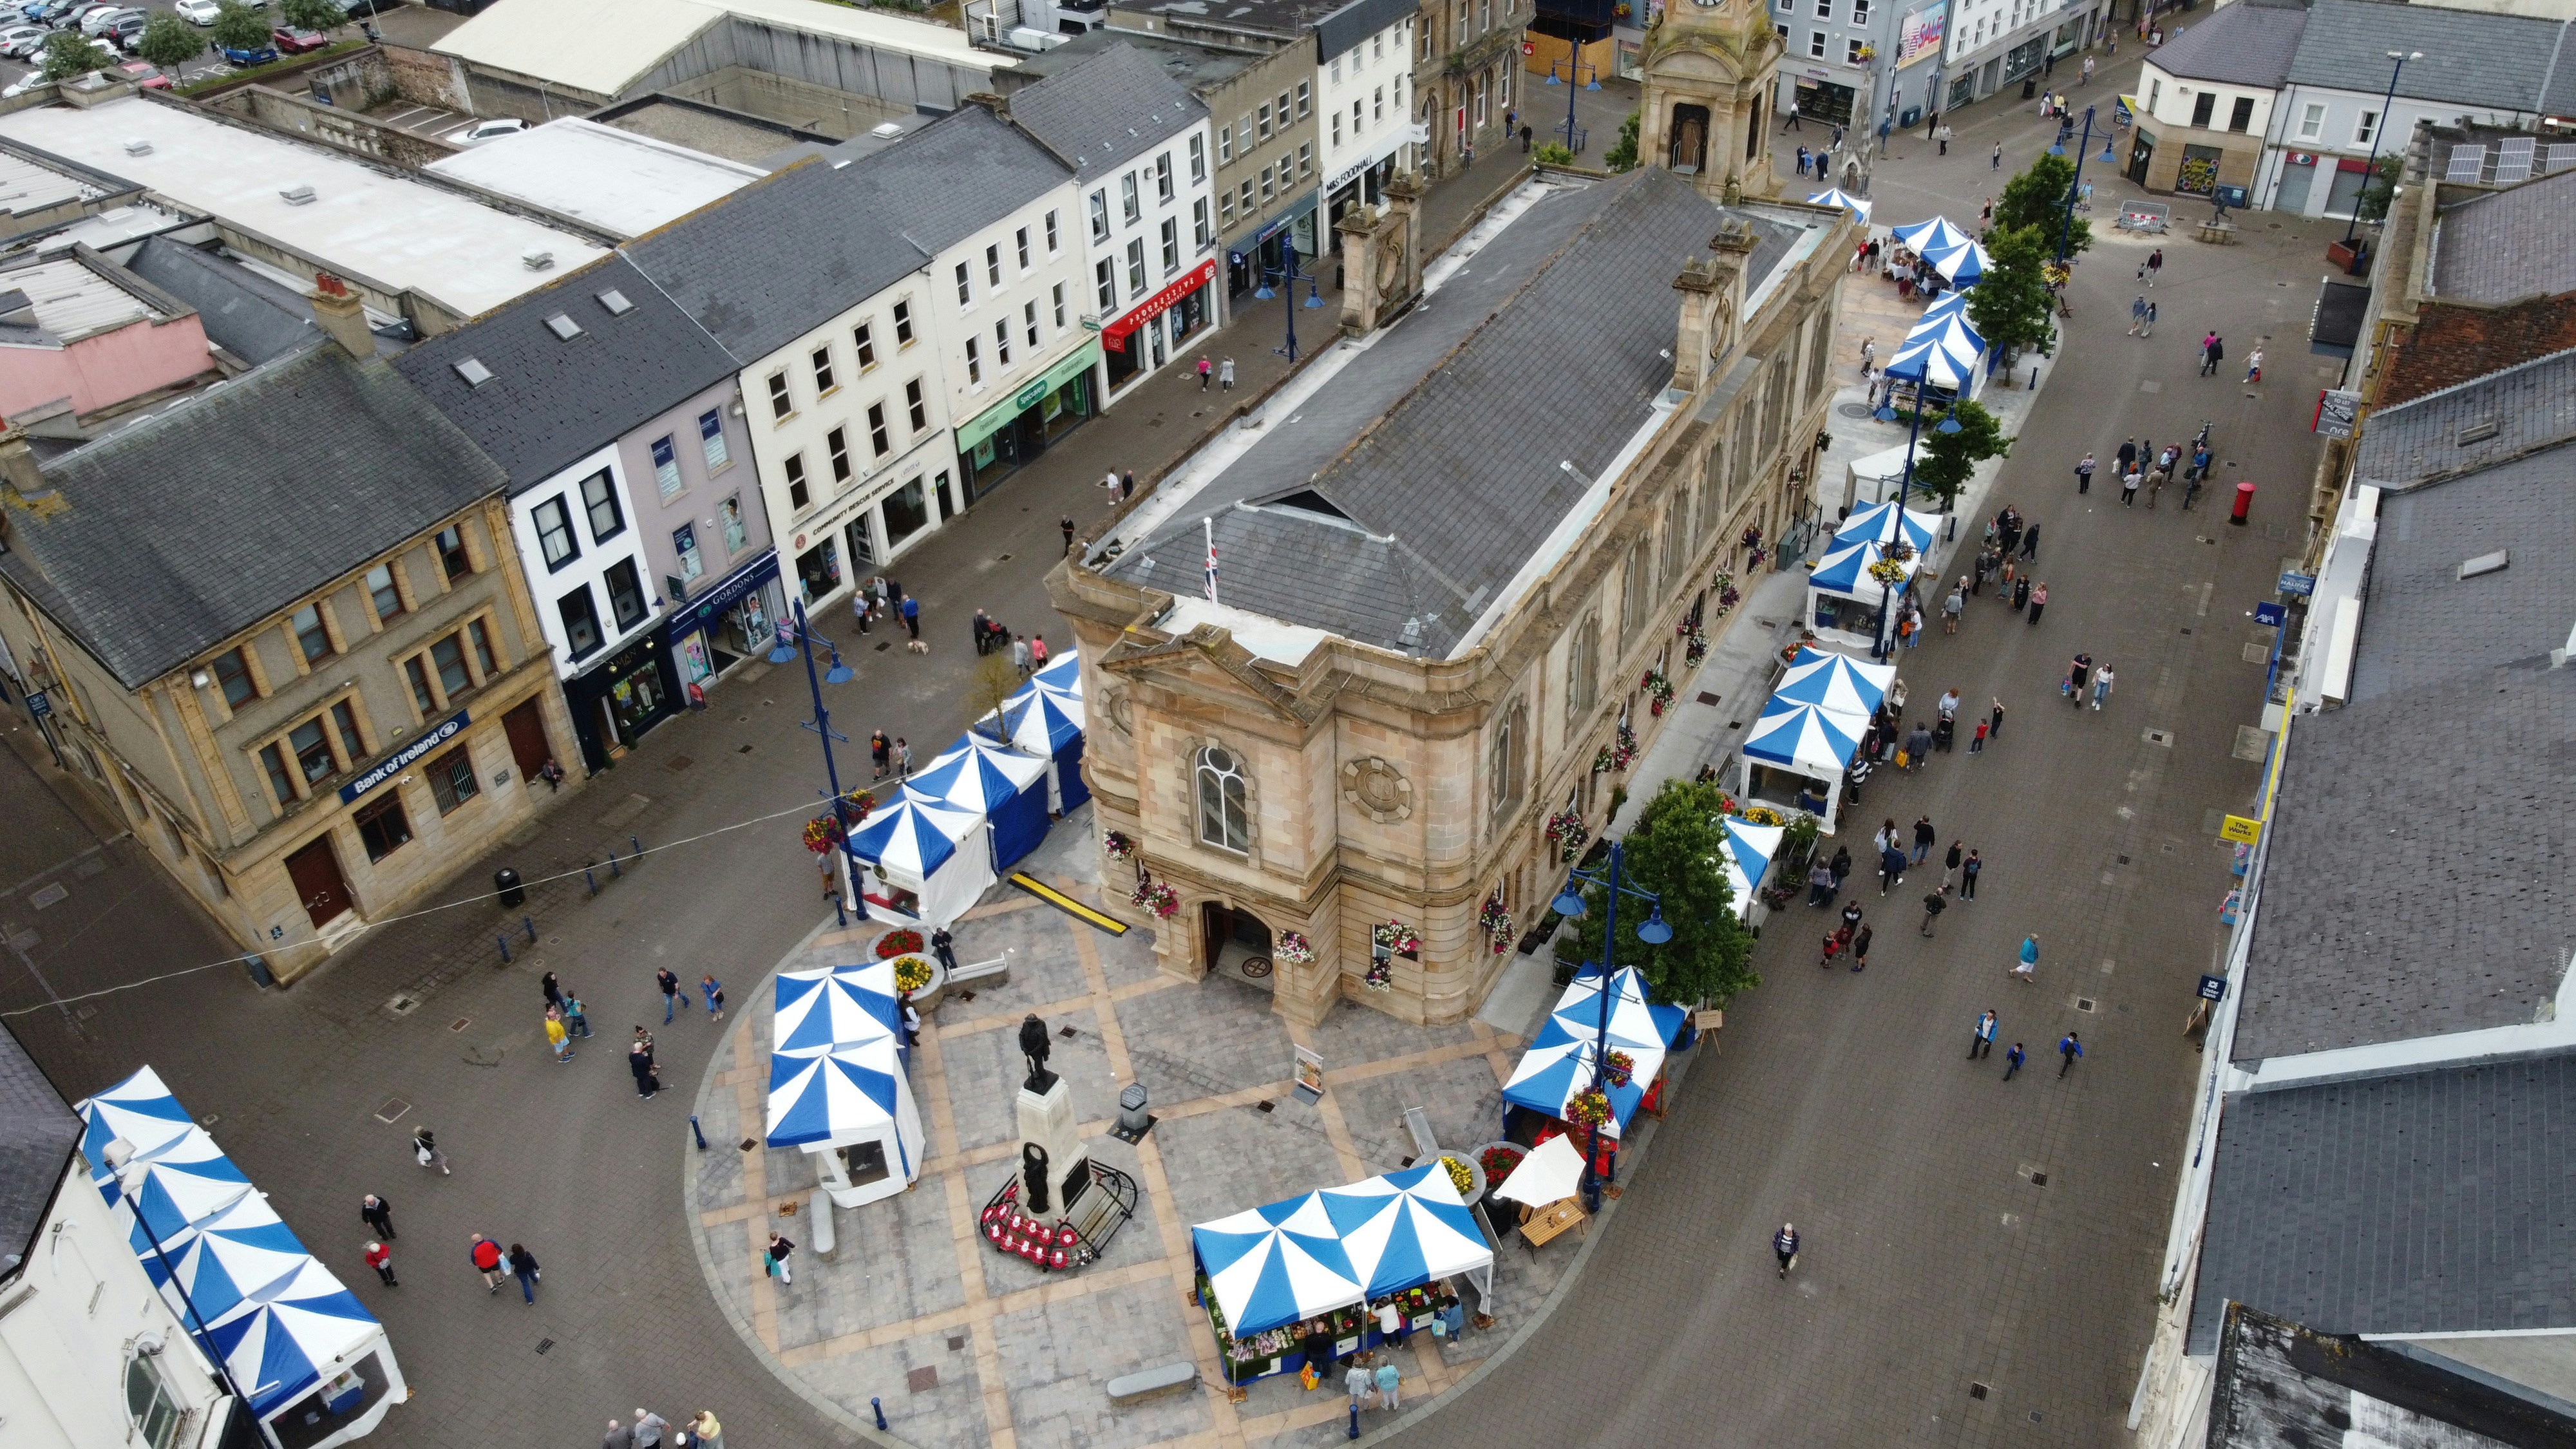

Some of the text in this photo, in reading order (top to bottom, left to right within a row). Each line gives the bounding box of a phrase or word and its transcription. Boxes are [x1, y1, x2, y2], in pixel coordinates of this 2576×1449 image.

[1918, 15, 1943, 49] SALE
[1326, 155, 1374, 194] M&S FOODHALL
[1128, 278, 1195, 326] PROGRESSIVE
[1019, 384, 1046, 405] Specsavers
[2334, 408, 2349, 421] DONE
[2329, 426, 2349, 436] nre
[812, 477, 895, 536] COMMUNITY RESCUE SERVICE
[712, 573, 755, 605] GORDONS
[2280, 580, 2310, 590] HALIFAX
[2254, 614, 2275, 625] AXA
[354, 732, 440, 794] Bank of Ireland
[2228, 826, 2252, 837] Works
